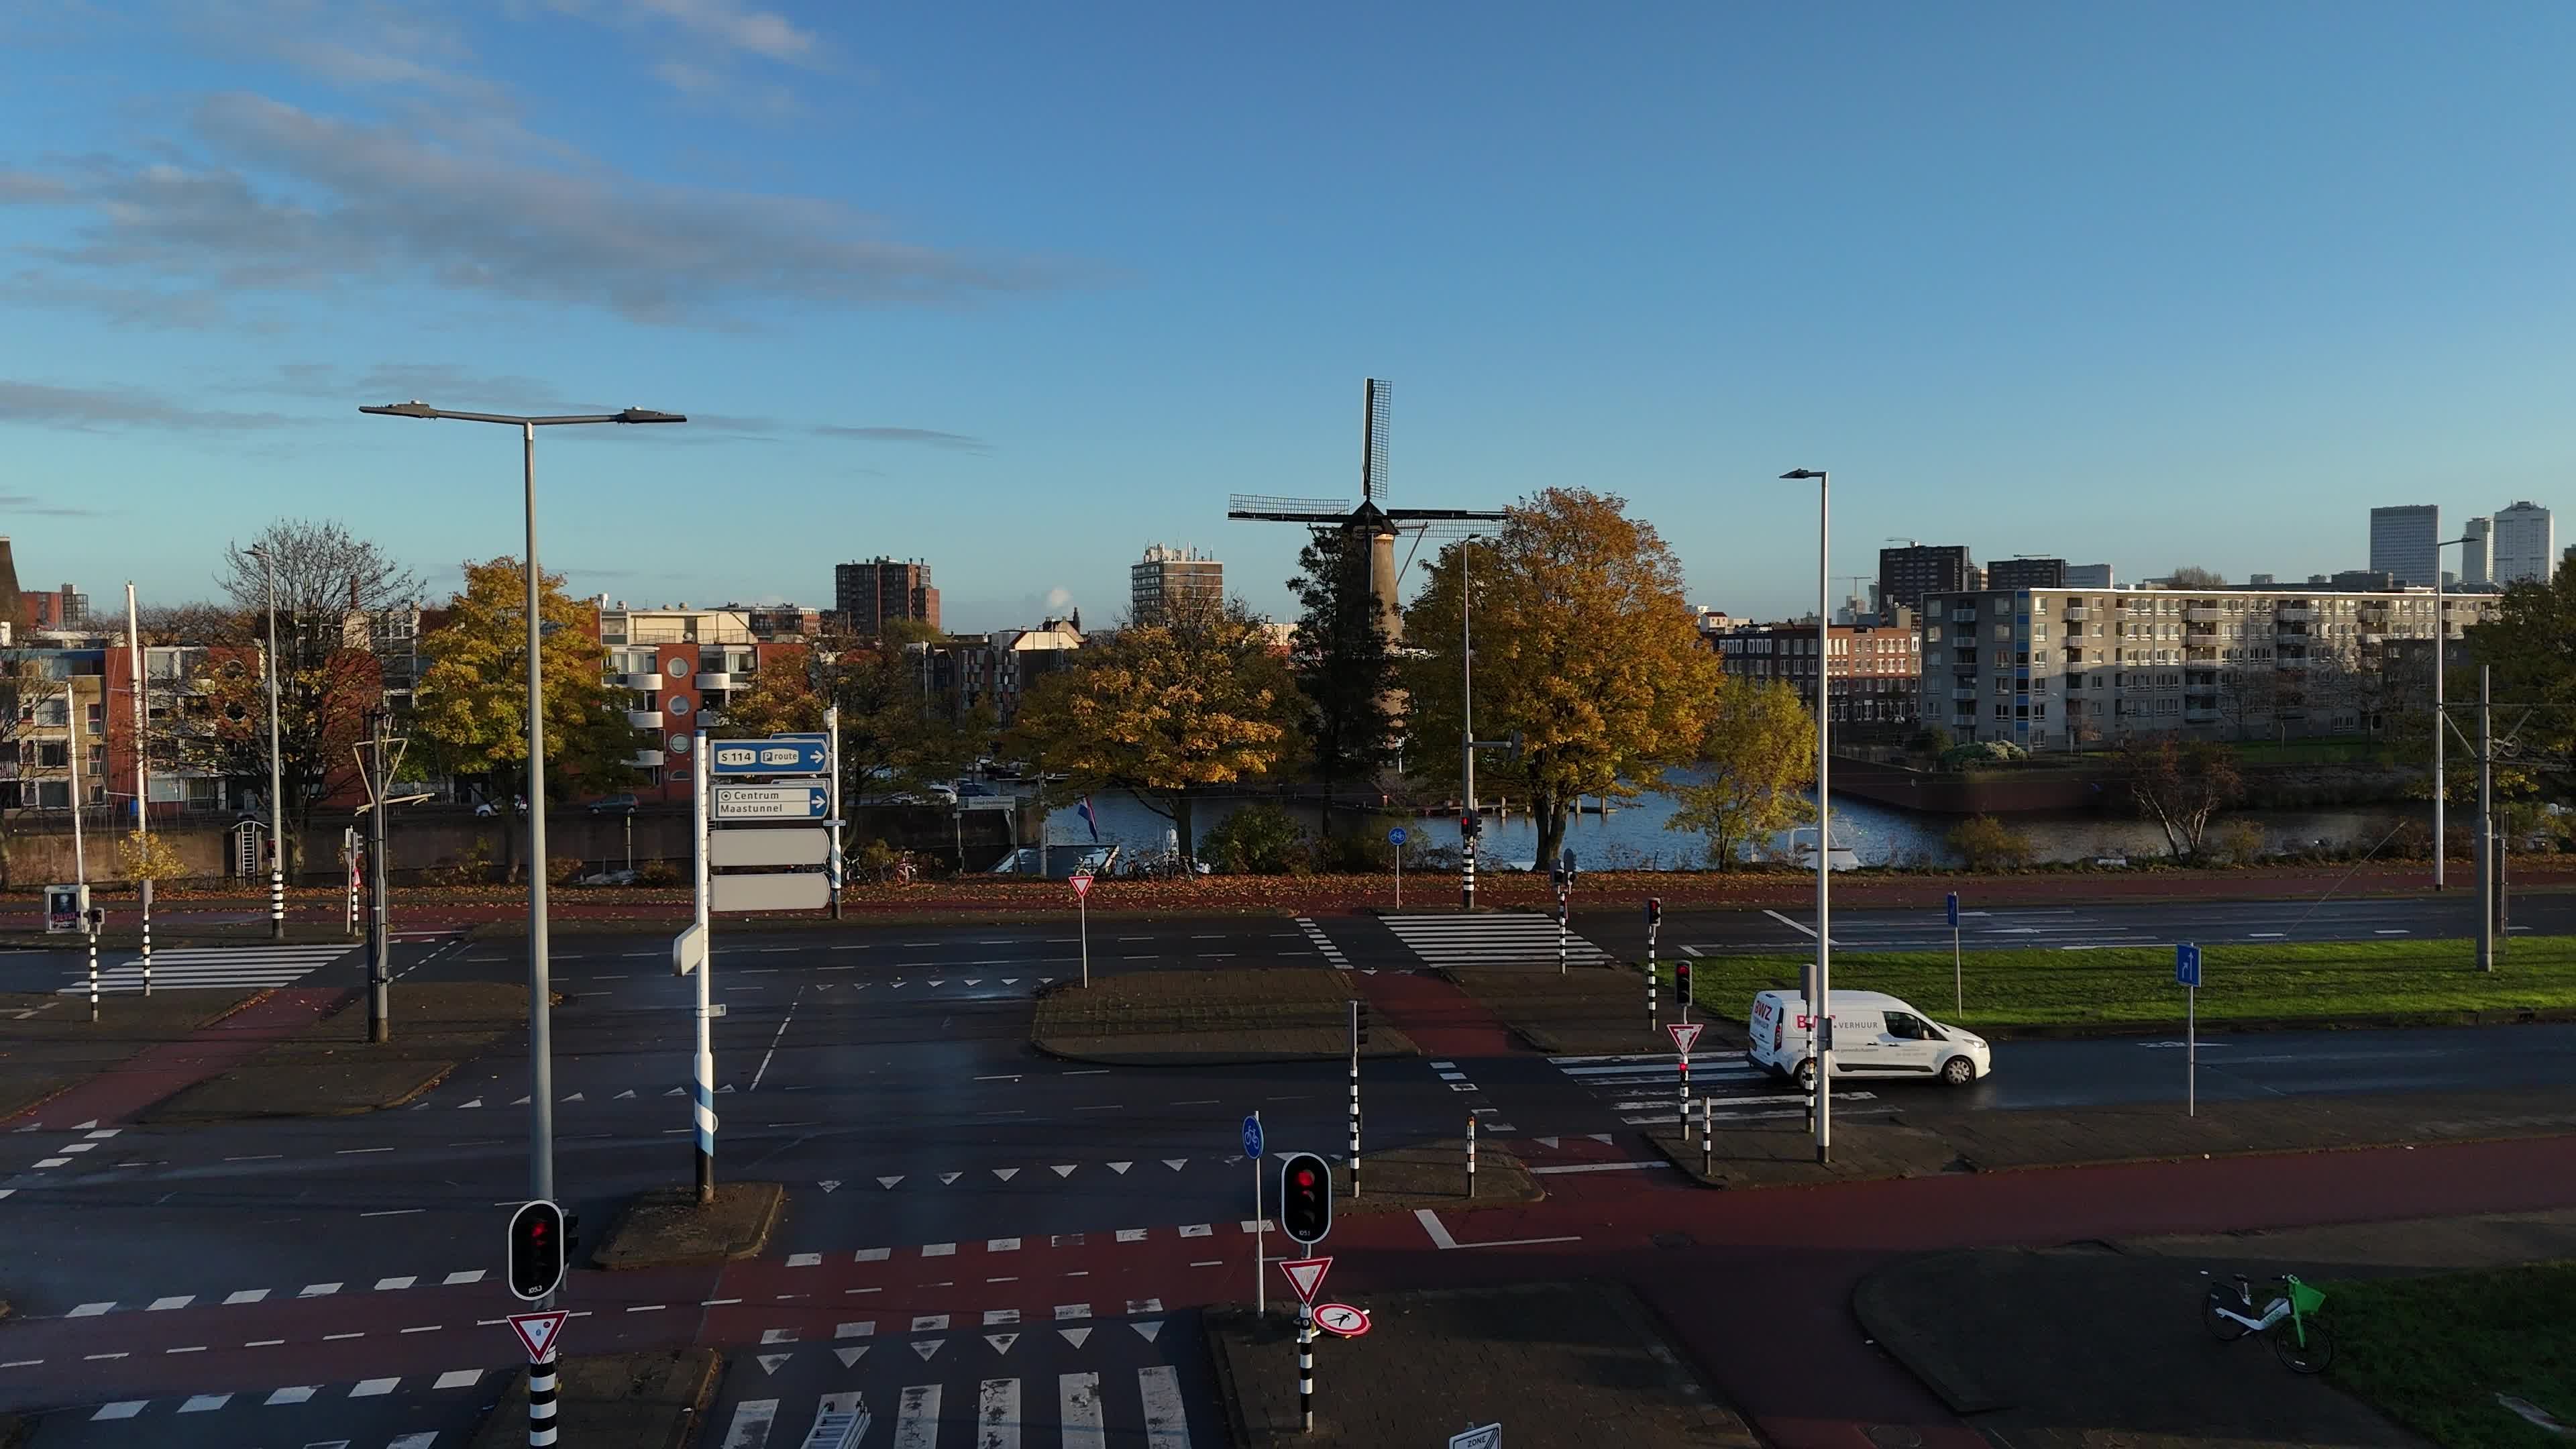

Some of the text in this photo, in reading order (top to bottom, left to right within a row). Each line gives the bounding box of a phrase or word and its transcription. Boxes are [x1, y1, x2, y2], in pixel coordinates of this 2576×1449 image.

[721, 753, 751, 761] S 114
[774, 752, 798, 760] route
[734, 791, 779, 800] Centrum
[720, 804, 782, 813] Maastunnel
[1754, 1000, 1772, 1021] BWZ
[1467, 1436, 1487, 1448] ZONE
